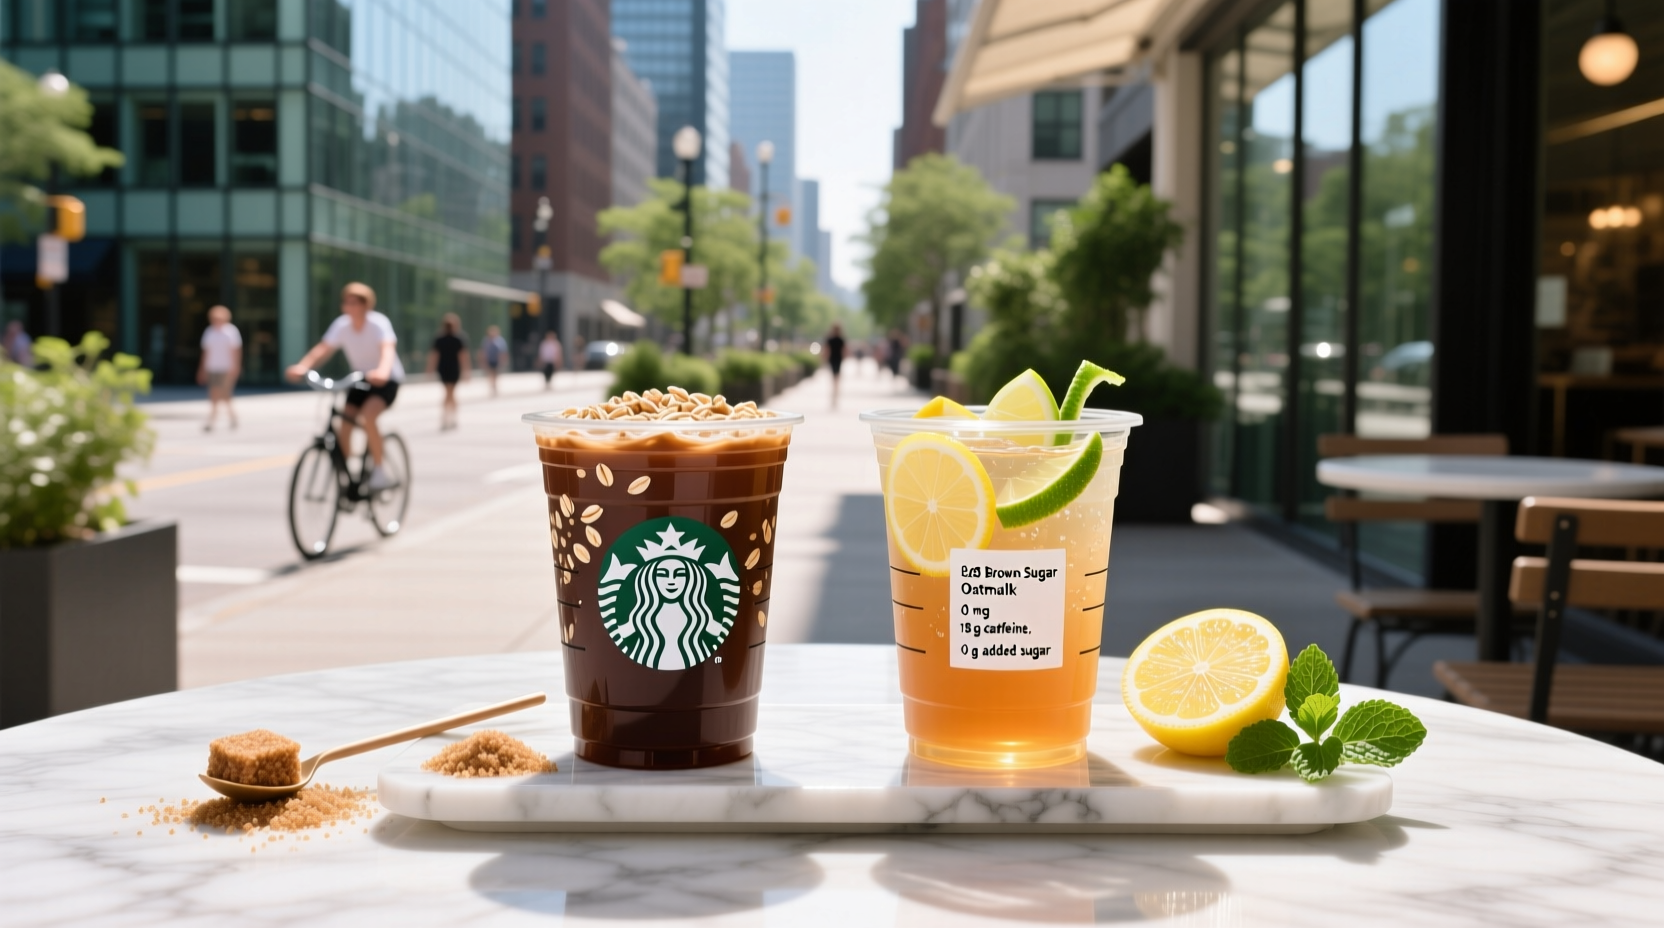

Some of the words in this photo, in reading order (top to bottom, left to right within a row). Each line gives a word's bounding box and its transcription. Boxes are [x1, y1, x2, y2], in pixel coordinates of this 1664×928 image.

[985, 566, 1021, 578] Brown
[1023, 566, 1058, 582] Sugar
[972, 607, 990, 620] mg
[973, 625, 981, 637] g
[972, 647, 979, 660] g
[982, 643, 1017, 656] added
[1020, 647, 1052, 660] sugar
